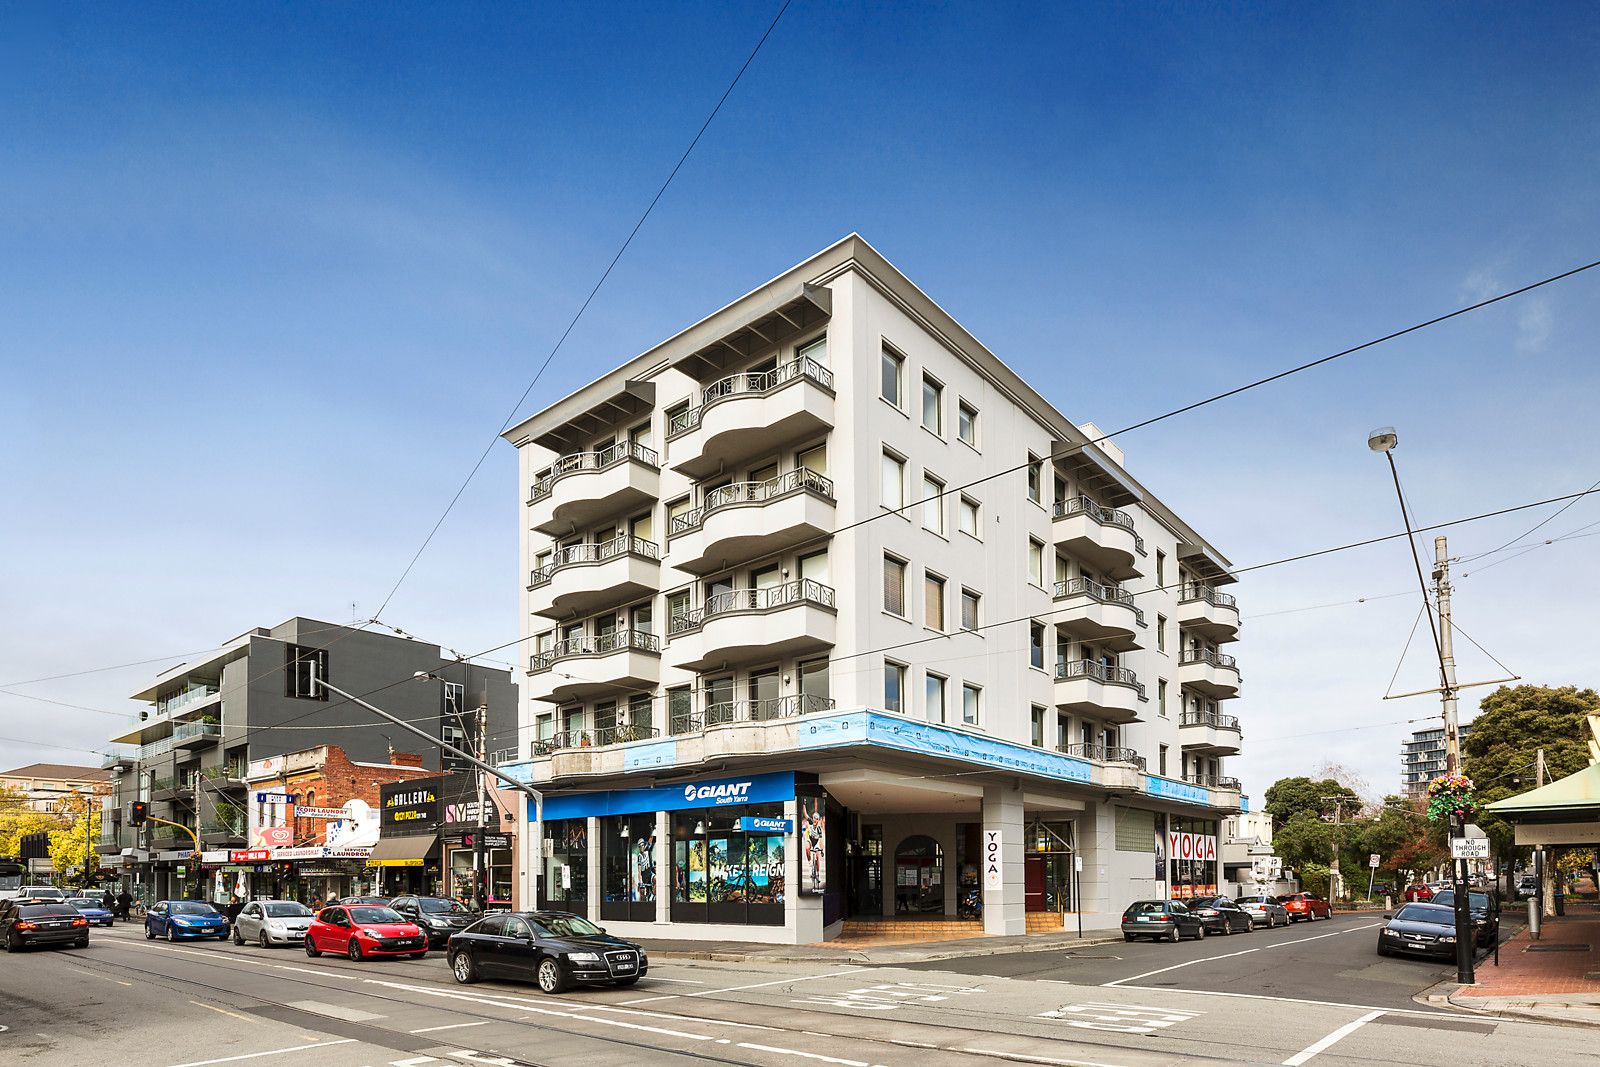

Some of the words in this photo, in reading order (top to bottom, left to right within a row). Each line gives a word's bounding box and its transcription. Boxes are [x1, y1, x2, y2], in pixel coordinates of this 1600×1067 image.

[394, 790, 428, 807] GALLERY
[697, 782, 752, 799] GIANT
[715, 796, 733, 805] South
[733, 795, 749, 803] Yarra
[760, 820, 786, 828] GIANT
[987, 832, 998, 874] YOGA
[1169, 833, 1216, 859] YOGA
[752, 863, 785, 877] REIGN
